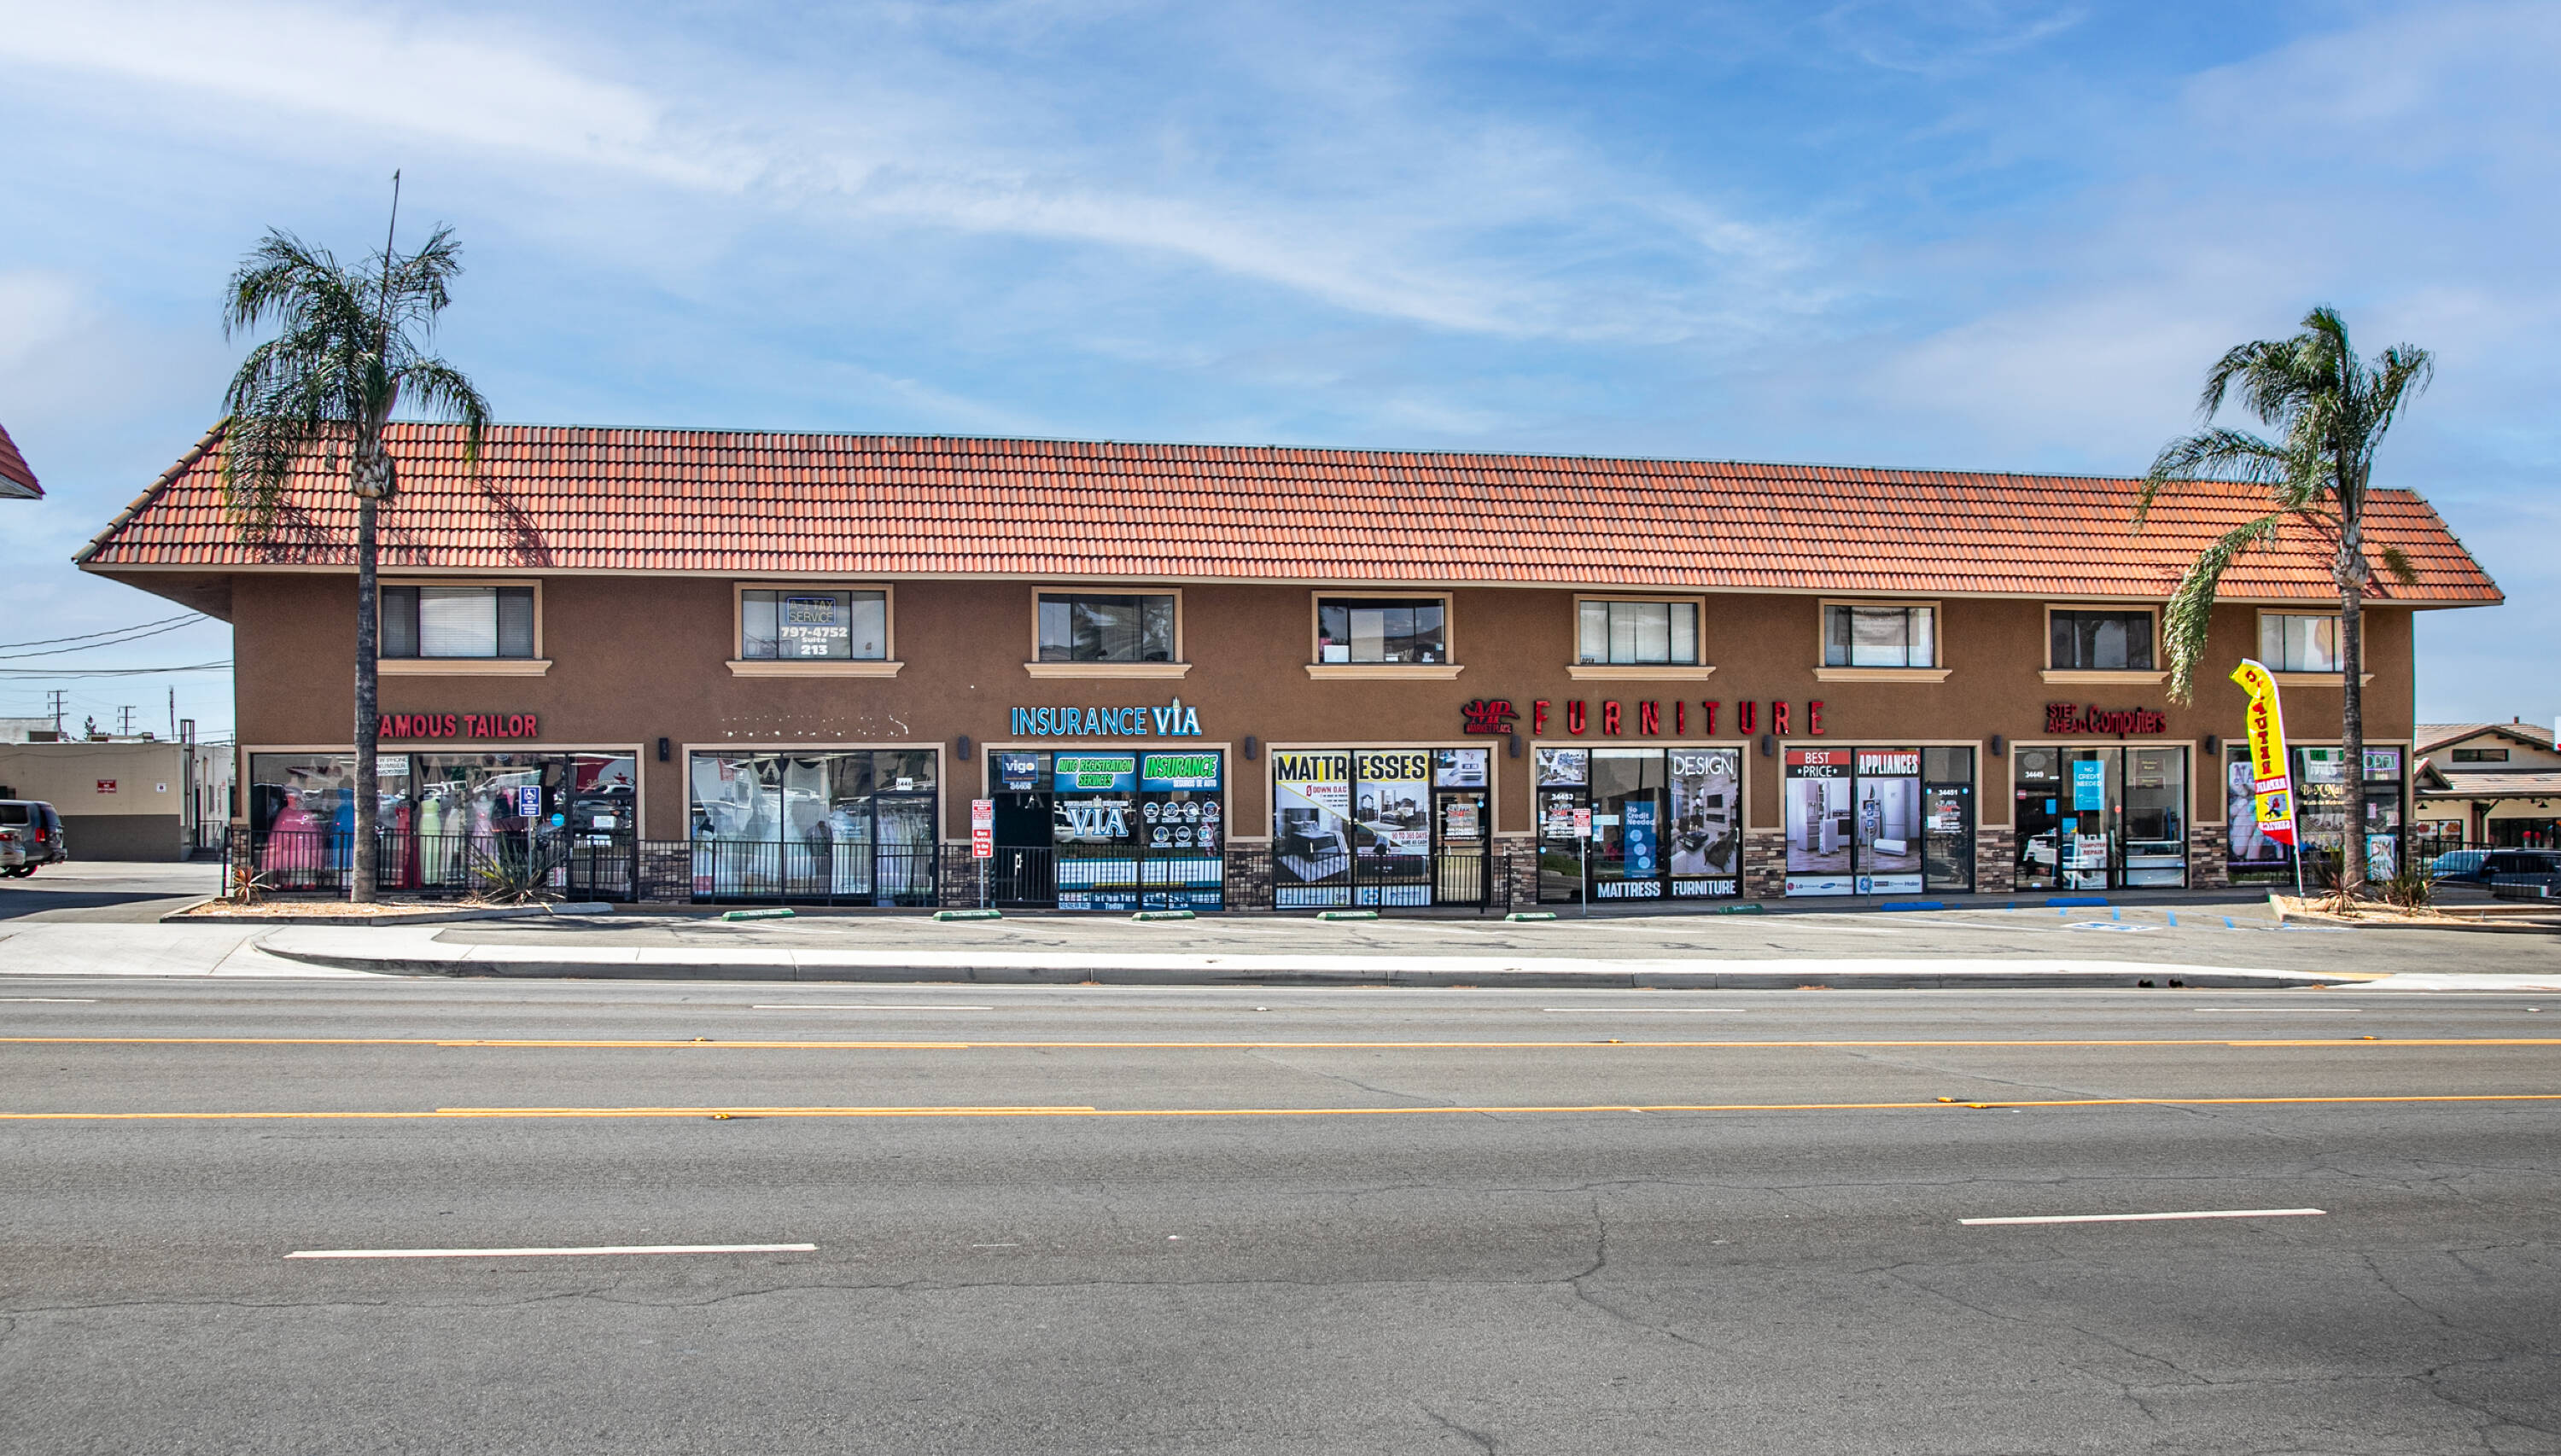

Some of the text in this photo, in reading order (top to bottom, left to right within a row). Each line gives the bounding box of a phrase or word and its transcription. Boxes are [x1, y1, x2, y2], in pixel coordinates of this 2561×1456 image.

[814, 600, 833, 610] TAX
[790, 611, 834, 622] SERVICE
[781, 626, 848, 638] 797-4752
[801, 644, 828, 655] 213
[2047, 703, 2078, 718] STEP
[377, 714, 538, 737] AMOUS TAILOR
[1012, 706, 1202, 736] INSURANCE VIA
[1533, 701, 1825, 736] FURNITURE
[2048, 718, 2086, 733] AHEAD
[2088, 704, 2167, 740] Computers
[1805, 752, 1830, 764] BEST
[1858, 754, 1918, 775] APPLIANCES
[2365, 754, 2397, 768] OPEN
[1005, 759, 1035, 773] vigo
[1058, 759, 1134, 772] AUTO REGISTRATION
[1145, 756, 1217, 778] INSURANCE
[1673, 756, 1734, 776] DESIGN
[1803, 765, 1832, 777] PRICE
[1077, 774, 1113, 787] SERVICES
[1313, 785, 1332, 794] DOWN
[1068, 807, 1129, 837] VIA
[1598, 881, 1661, 898] MATTRESS
[1672, 880, 1736, 896] FURNITURE
[1105, 902, 1125, 911] Today
